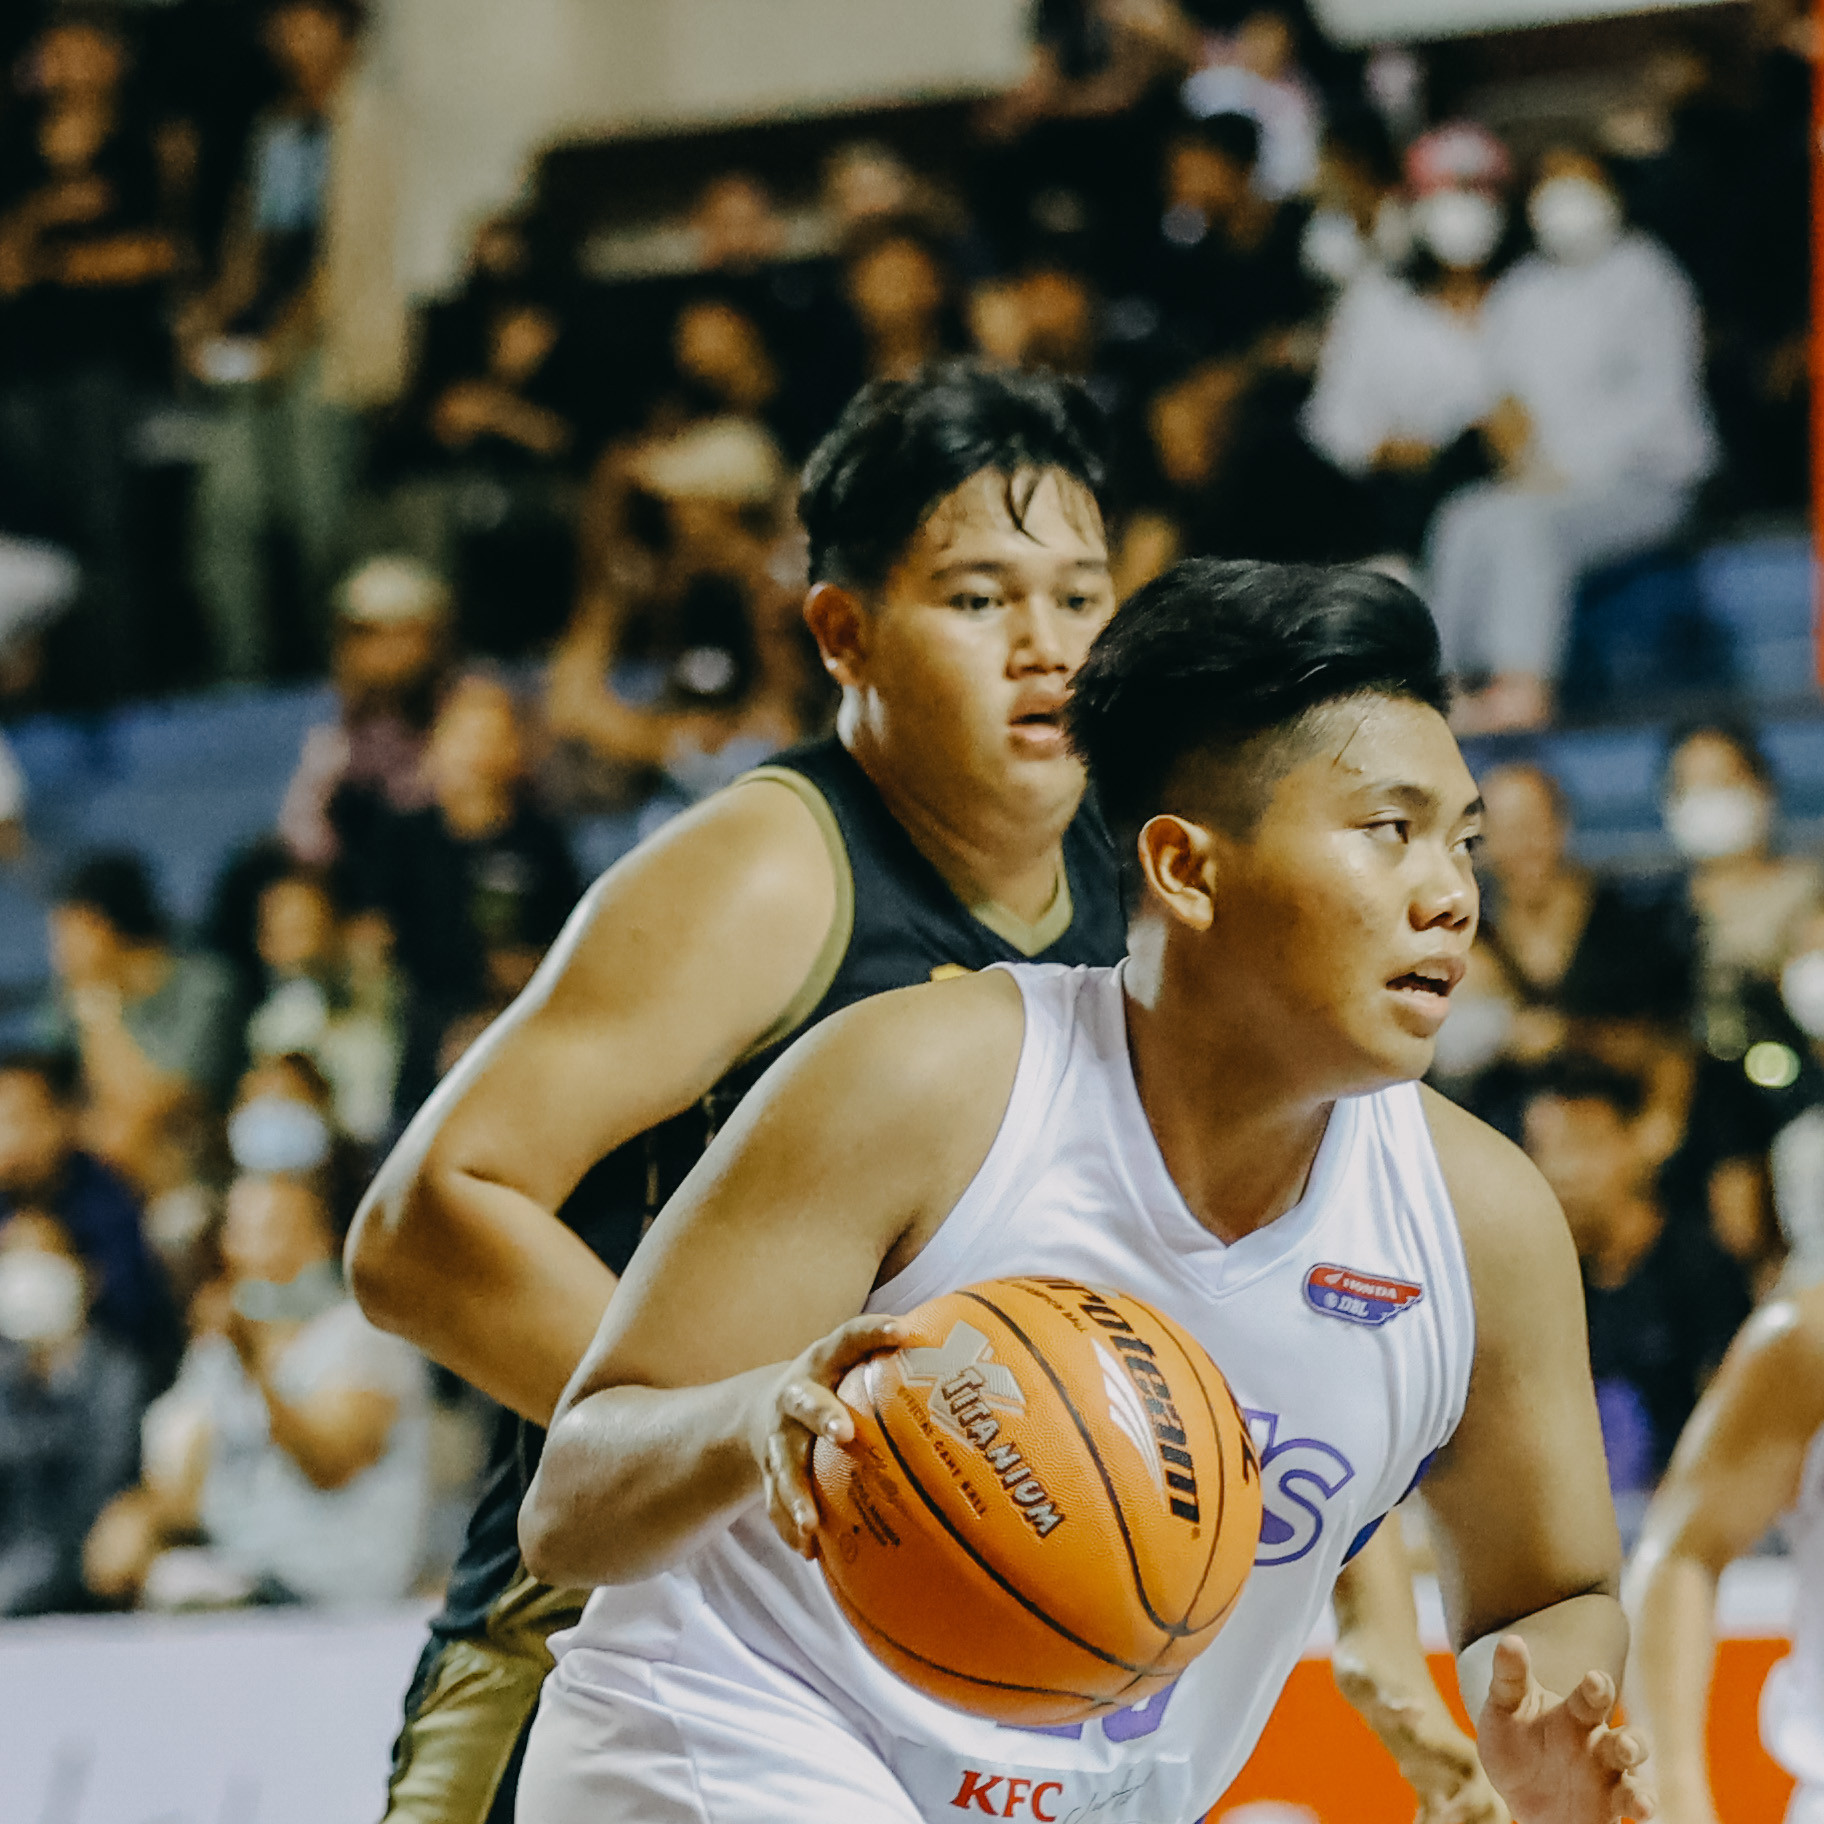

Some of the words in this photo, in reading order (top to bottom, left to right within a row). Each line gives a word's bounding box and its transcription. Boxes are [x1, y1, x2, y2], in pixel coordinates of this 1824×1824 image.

[1343, 1278, 1398, 1300] HONDA
[942, 1366, 1066, 1540] TITANIUM
[1024, 1276, 1201, 1524] roteam
[950, 1769, 1063, 1823] KFC
